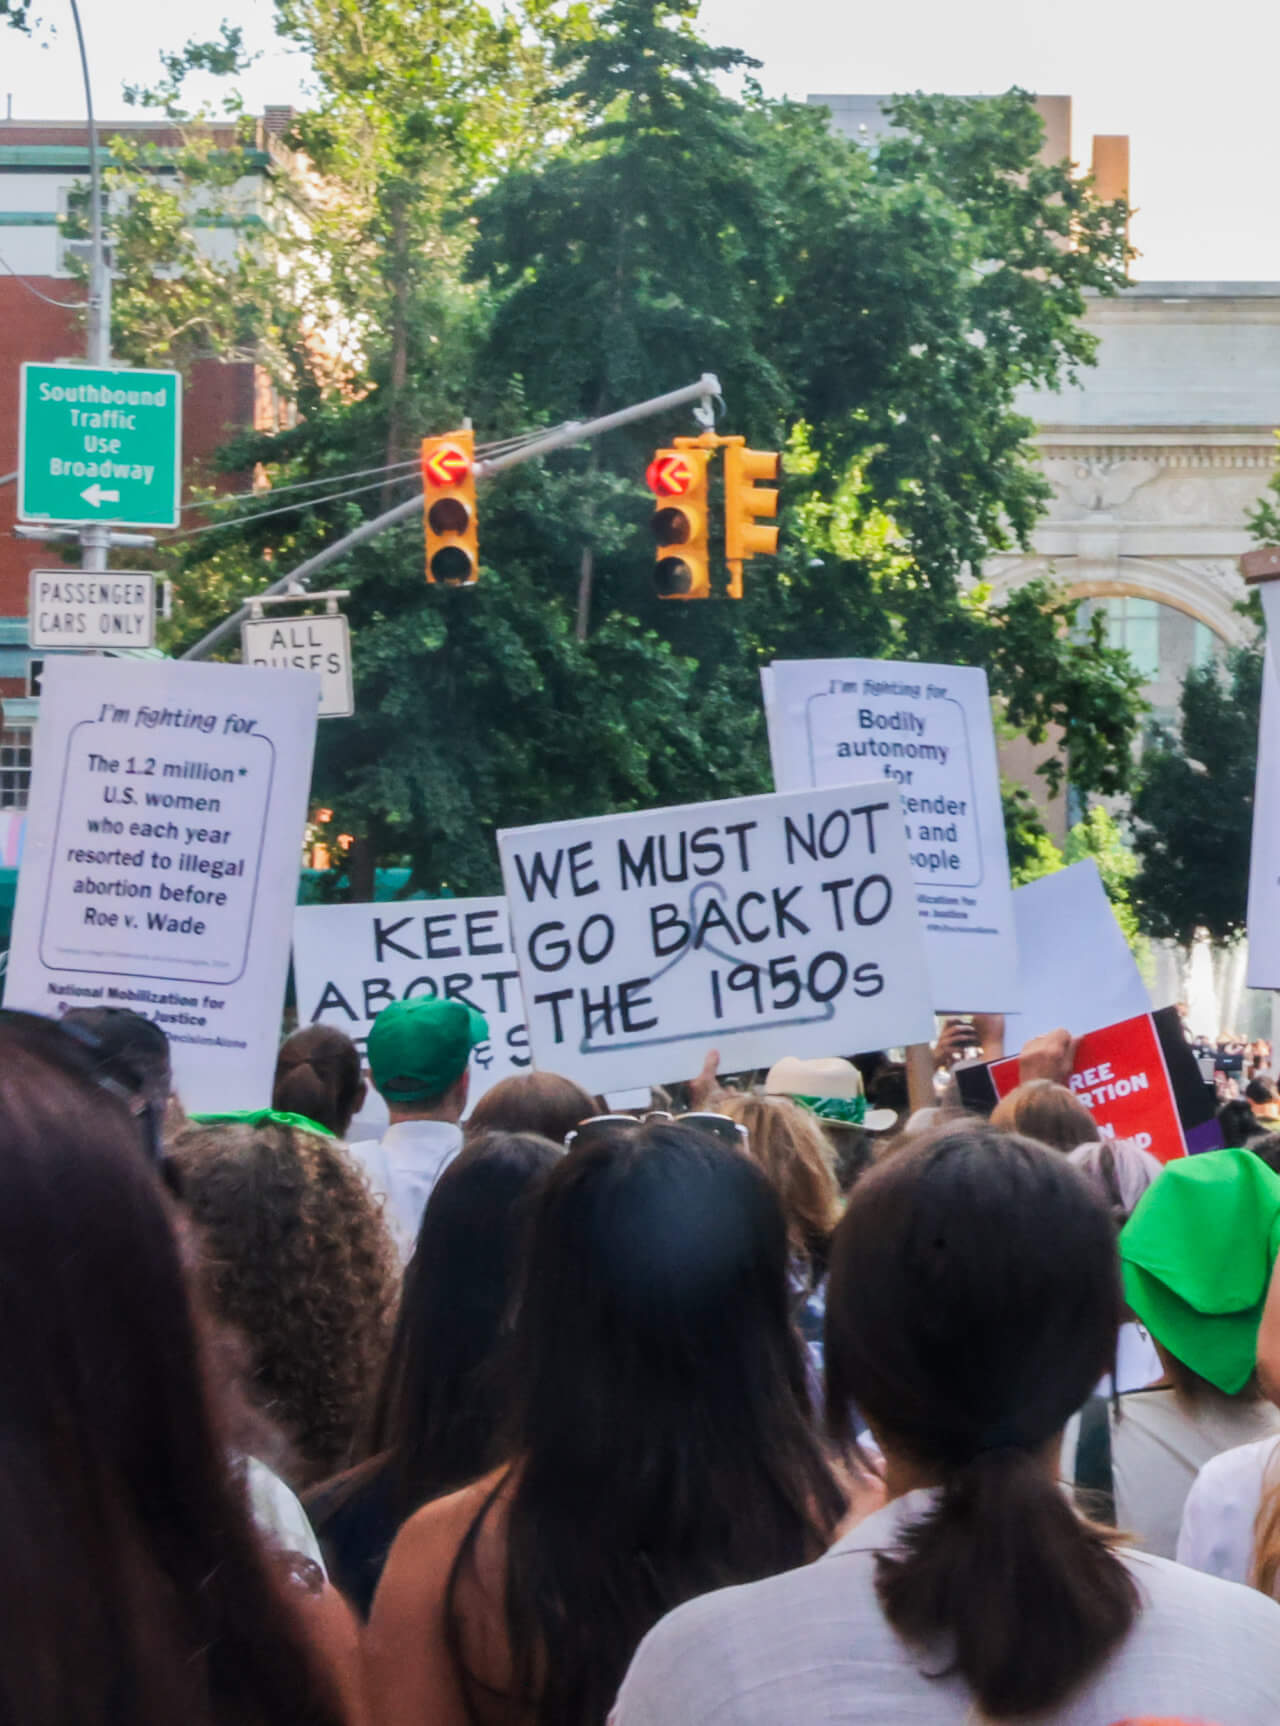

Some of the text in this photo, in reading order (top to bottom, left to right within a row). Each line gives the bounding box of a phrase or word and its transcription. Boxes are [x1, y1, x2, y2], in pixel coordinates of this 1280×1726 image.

[39, 383, 166, 407] Southbound
[70, 409, 136, 430] Traffic
[84, 435, 121, 454] Use
[50, 458, 155, 485] Broadway
[40, 583, 145, 606] PASSENGER
[40, 613, 145, 635] CARS ONLY
[270, 627, 322, 650] ALL
[99, 704, 258, 734] I'm fighting for
[859, 709, 925, 736] Bodily
[88, 754, 120, 774] The
[125, 757, 156, 776] 1.2
[837, 739, 949, 765] autonomy
[104, 786, 220, 813] U.S. women
[87, 817, 230, 846] who each year
[919, 825, 958, 843] and
[67, 847, 244, 880] resorted to illegal
[514, 802, 889, 902] WE MUST NOT
[73, 877, 227, 907] abortion before
[84, 907, 206, 935] Roe v. Wade
[528, 874, 892, 972] GO BACK TO
[203, 996, 225, 1010] for
[534, 951, 884, 1044] THE 1950s
